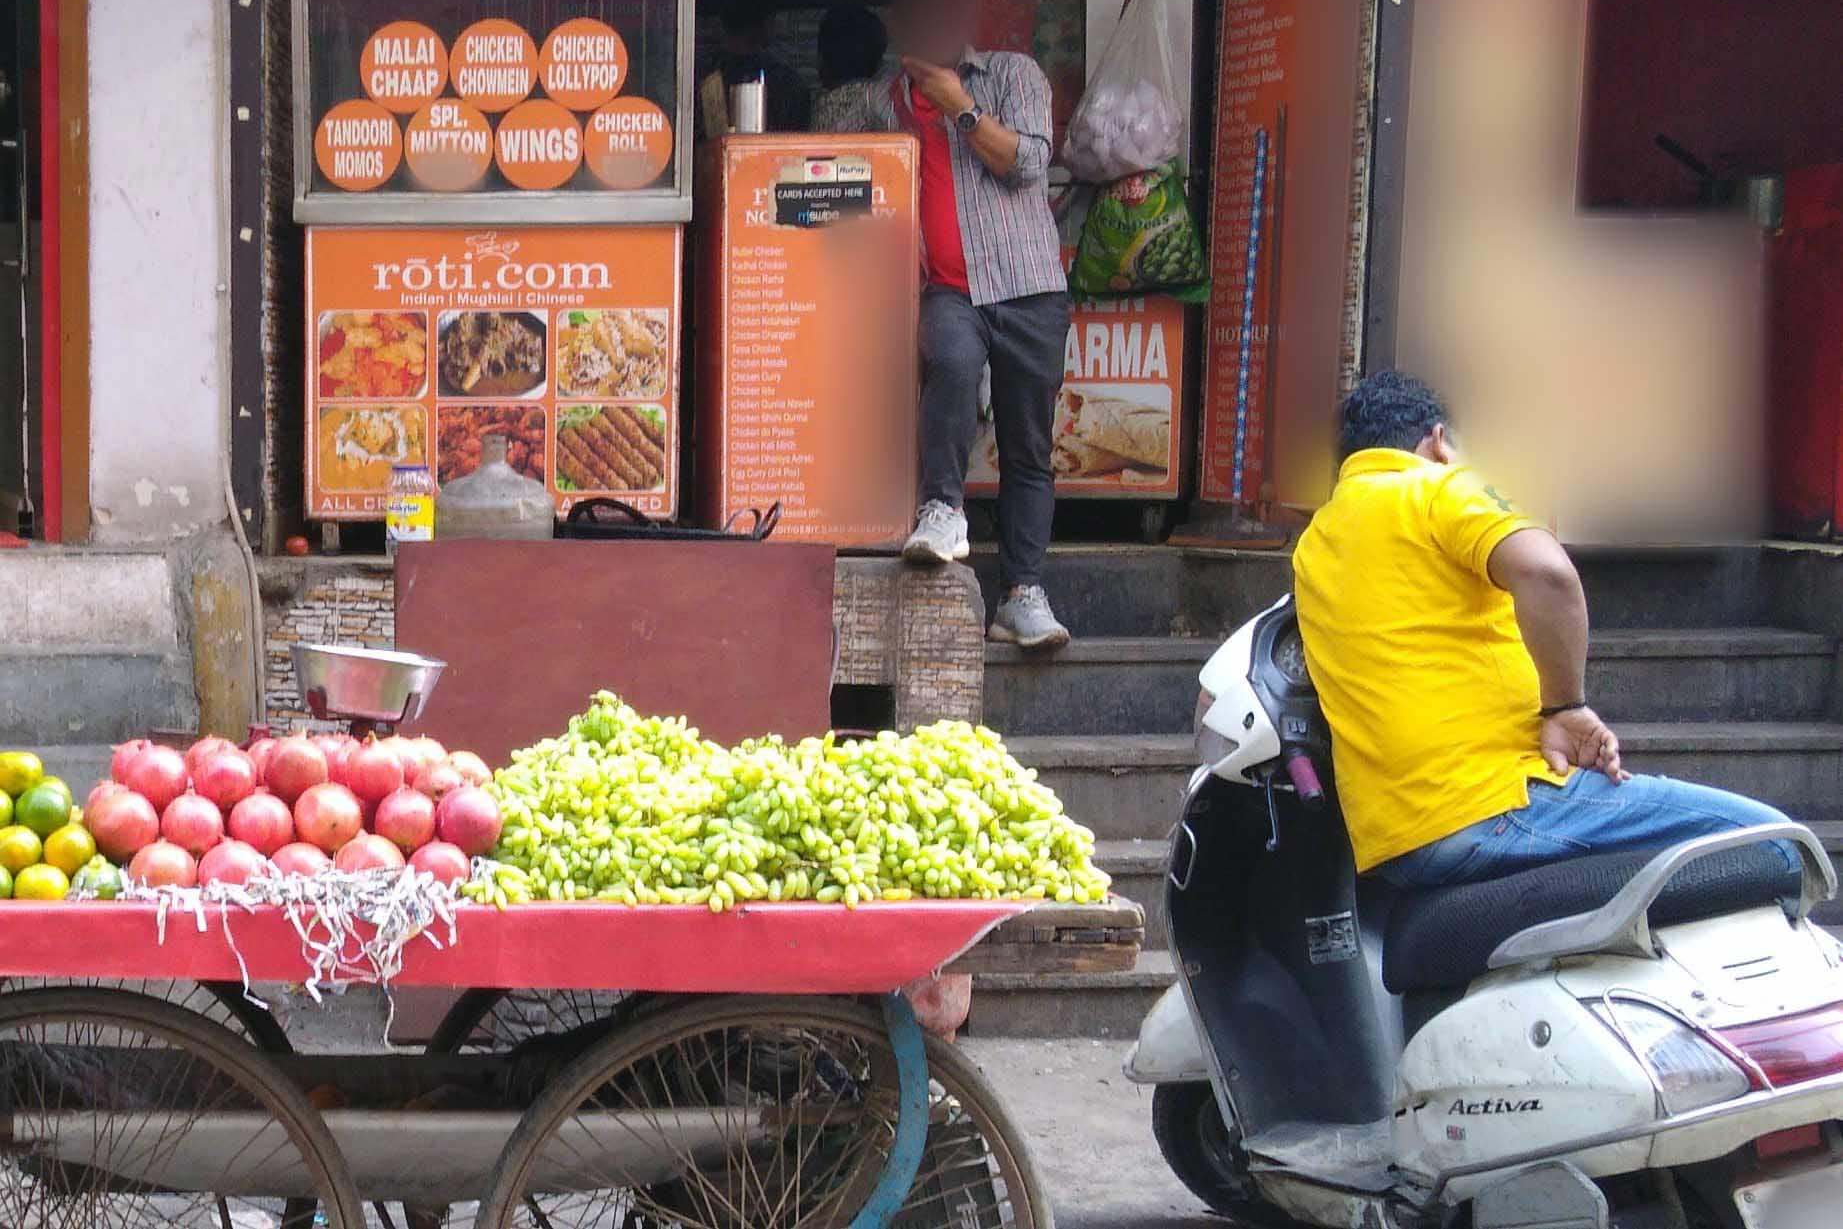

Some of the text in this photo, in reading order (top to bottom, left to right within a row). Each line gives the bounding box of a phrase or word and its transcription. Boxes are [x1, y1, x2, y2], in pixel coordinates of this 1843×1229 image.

[374, 37, 435, 65] MALAI
[465, 36, 523, 63] CHICKEN
[553, 35, 614, 62] CHICKEN
[371, 69, 439, 97] CHAAP
[459, 68, 530, 96] CHOWMEIN
[548, 64, 618, 92] LOLLYPOP
[430, 105, 468, 129] SPL.
[594, 113, 662, 131] CHICKEN
[326, 119, 392, 147] TANDOORI
[411, 131, 486, 154] MUTTON
[501, 128, 578, 163] WINGS
[608, 133, 648, 152] ROLL
[334, 151, 384, 178] MOMOS
[777, 189, 803, 200] CARDS
[803, 188, 841, 199] ACCEPTED
[844, 187, 864, 198] HERE
[400, 291, 585, 307] Indian Mughlai Chinese
[1063, 322, 1169, 379] ARMA
[321, 496, 357, 511] ALL
[1448, 1098, 1543, 1115] Activa
